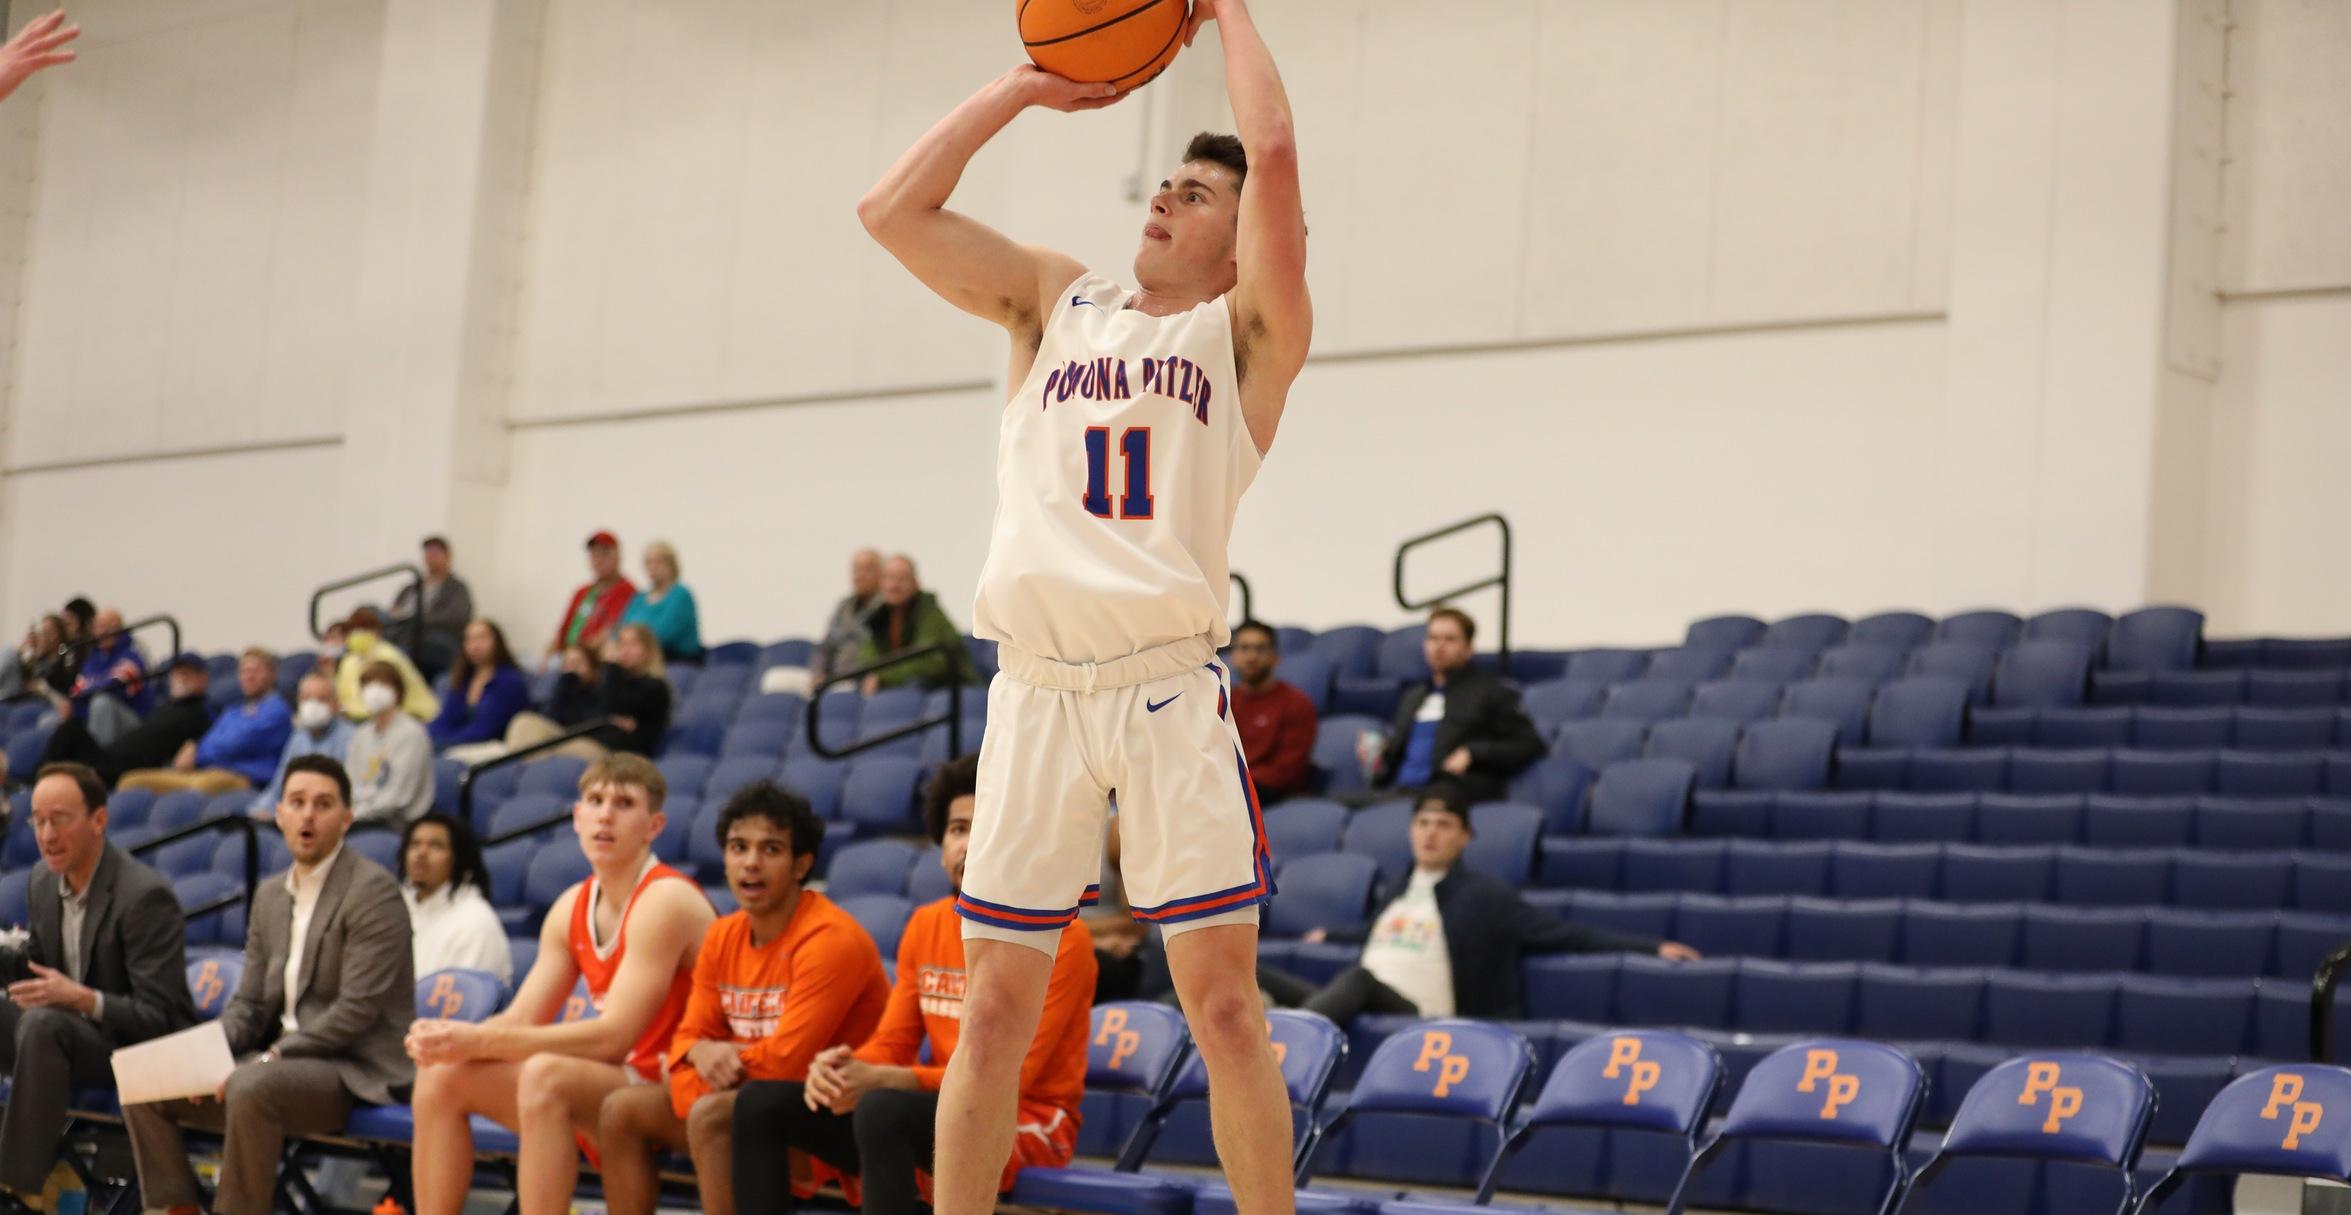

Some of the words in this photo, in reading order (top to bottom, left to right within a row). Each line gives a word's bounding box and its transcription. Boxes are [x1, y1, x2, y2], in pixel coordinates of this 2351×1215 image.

[1082, 425, 1154, 520] 11
[1095, 1008, 1141, 1070] PP
[1413, 1031, 1470, 1098] PP
[1602, 1037, 1662, 1105] PP
[1796, 1048, 1861, 1120] PP
[2018, 1060, 2084, 1134] PP
[2260, 1072, 2324, 1150] PP
